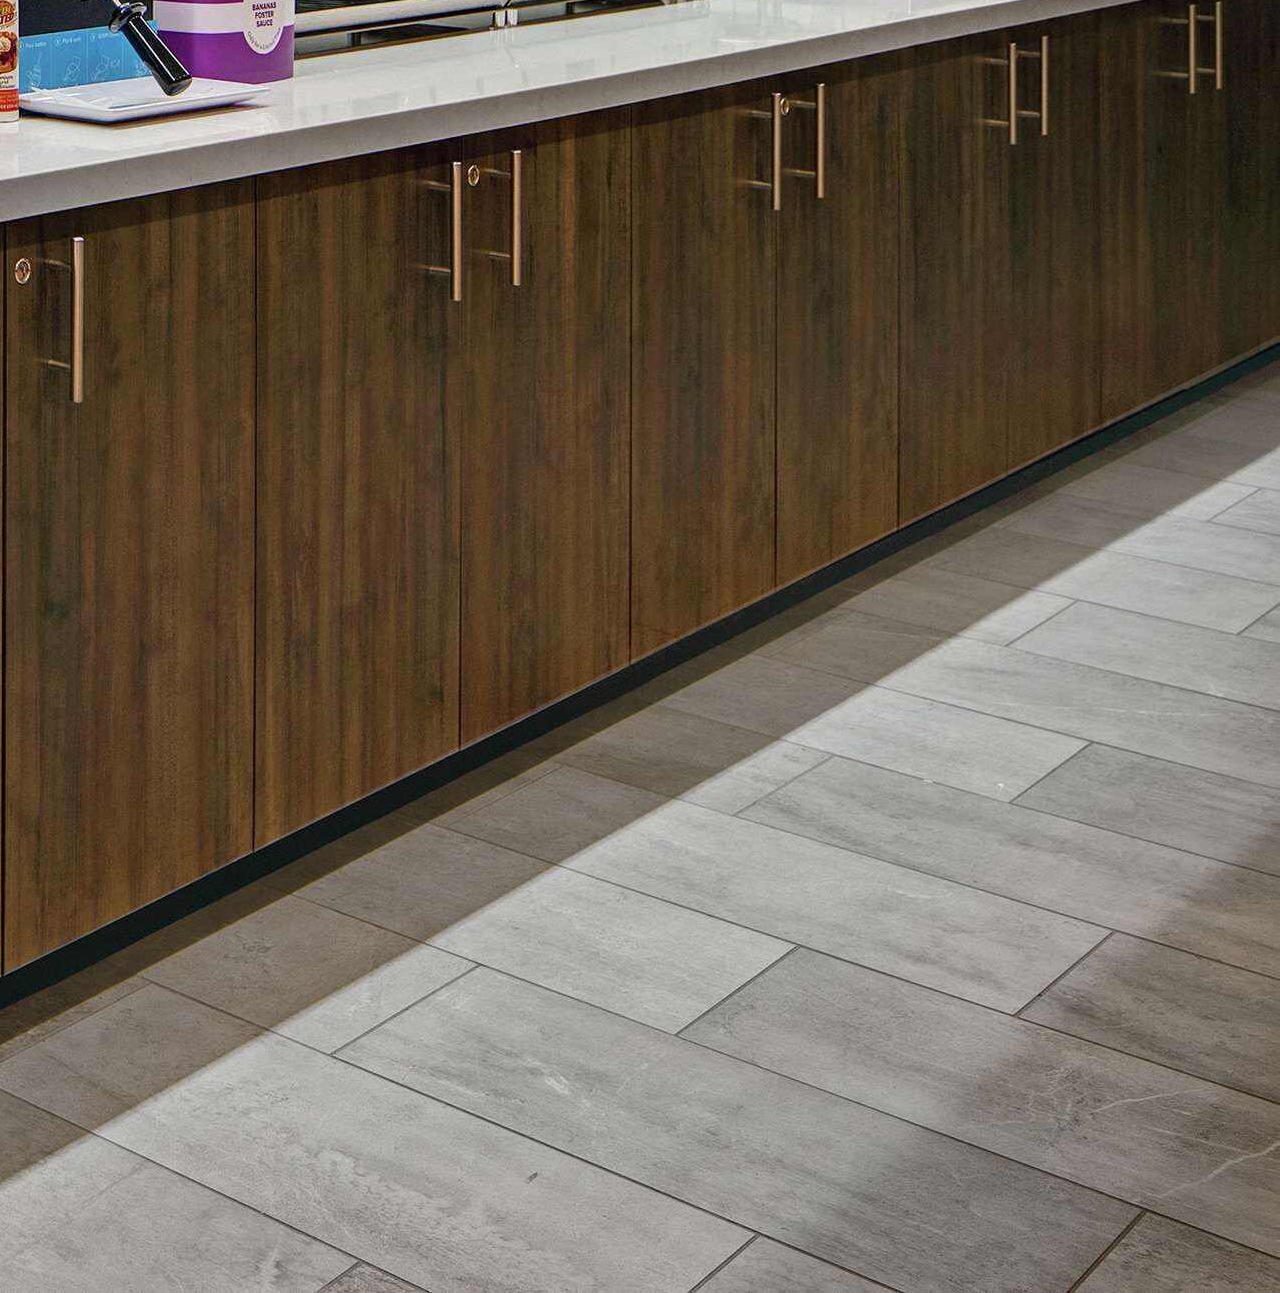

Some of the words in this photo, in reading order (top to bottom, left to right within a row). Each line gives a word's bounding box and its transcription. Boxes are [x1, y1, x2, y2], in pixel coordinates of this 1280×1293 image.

[252, 1, 277, 11] BANANAS
[255, 10, 274, 19] FOSTER
[256, 19, 273, 28] SAUCE
